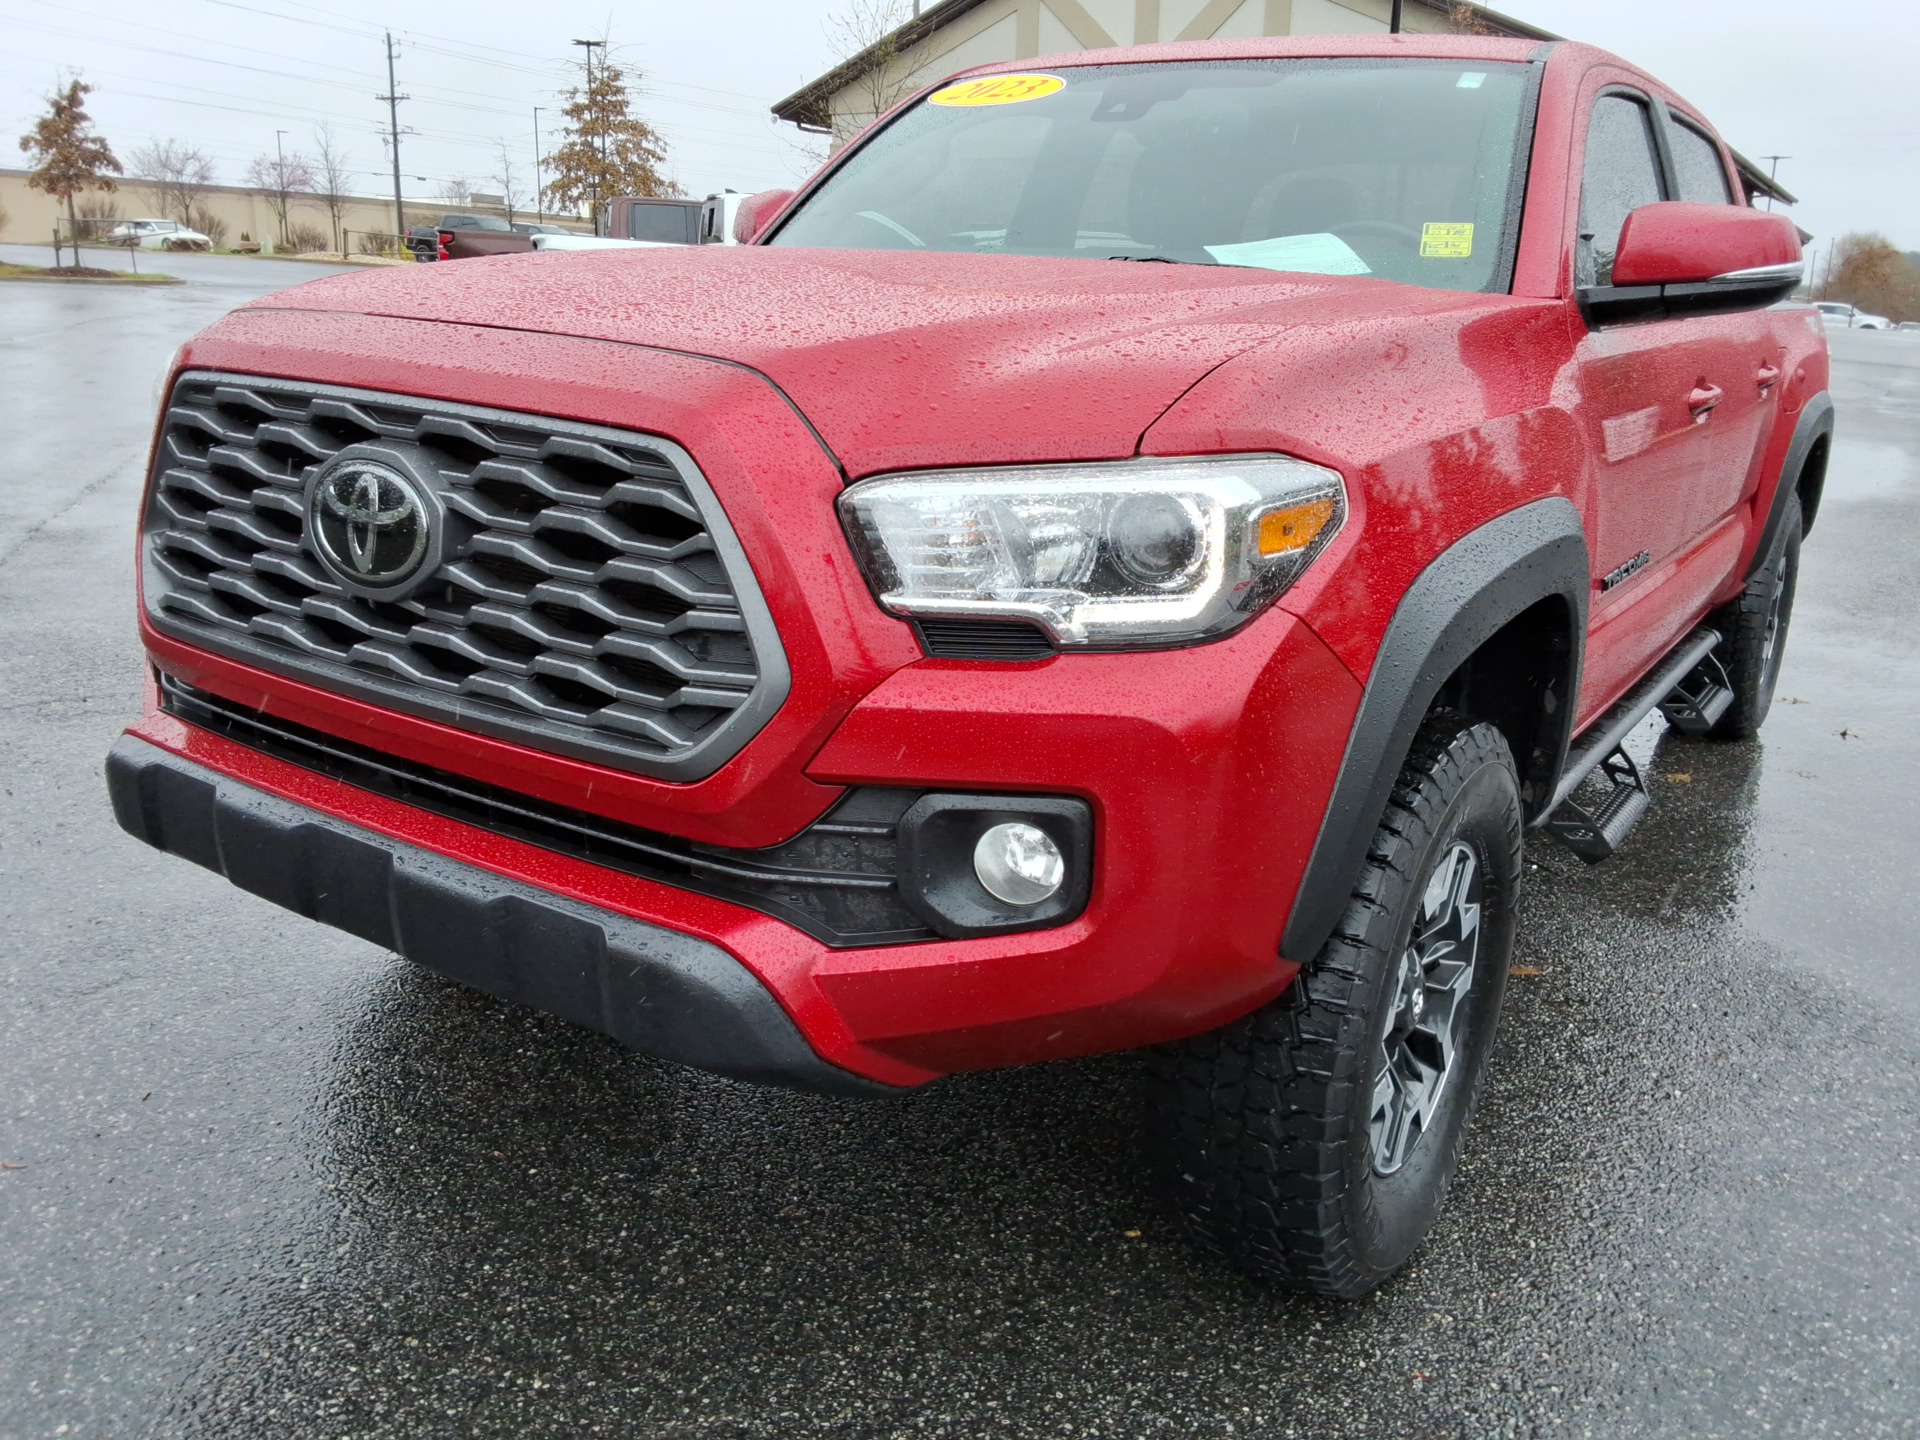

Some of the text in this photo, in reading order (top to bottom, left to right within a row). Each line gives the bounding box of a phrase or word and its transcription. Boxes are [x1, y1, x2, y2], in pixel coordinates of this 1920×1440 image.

[944, 79, 1050, 101] 2023
[1602, 549, 1649, 591] TACOMA
[1501, 797, 1521, 916] KELLY
